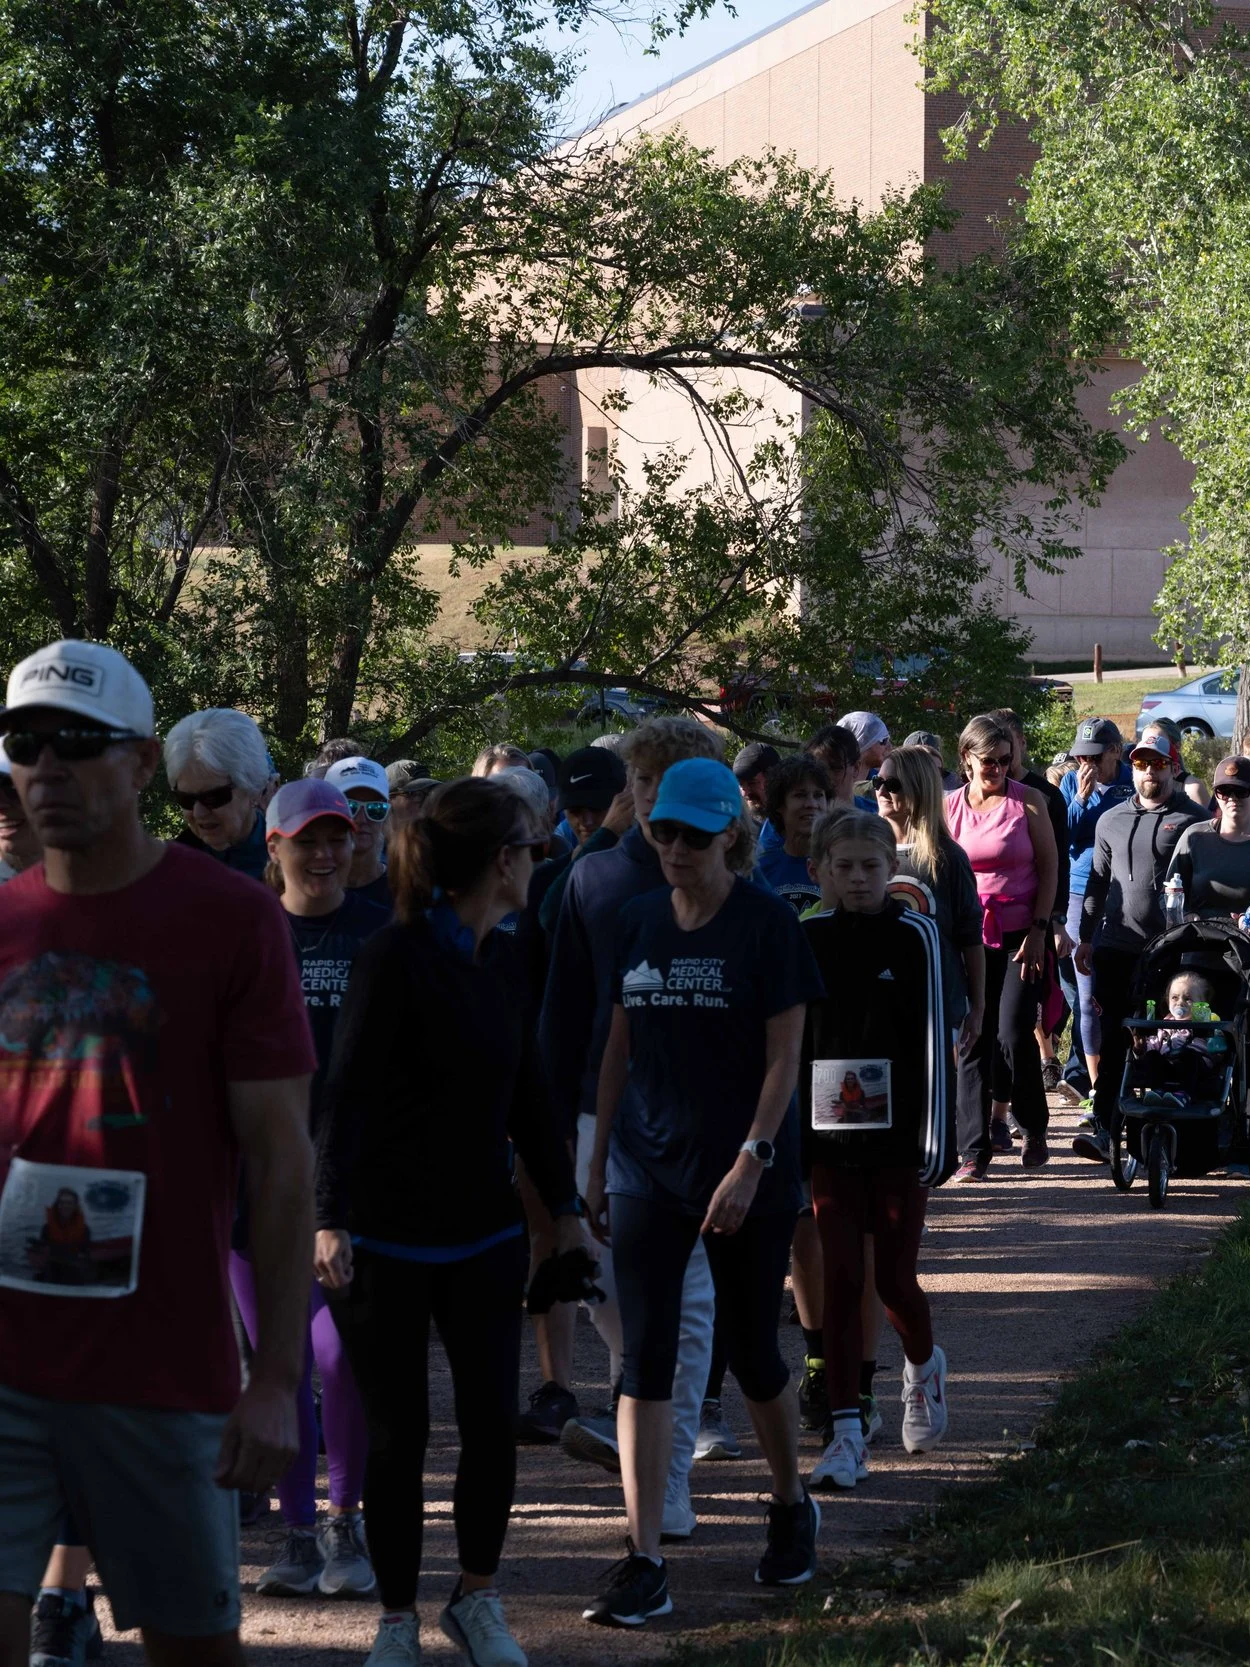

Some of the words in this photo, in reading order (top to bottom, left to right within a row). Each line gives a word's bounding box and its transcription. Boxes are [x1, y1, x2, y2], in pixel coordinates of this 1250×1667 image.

[21, 665, 93, 687] PING
[302, 959, 335, 968] RAPID
[336, 959, 352, 968] CIT
[671, 958, 700, 966] RAPID
[702, 958, 727, 967] CITY
[668, 966, 724, 978] MEDICAL
[301, 979, 349, 992] CENTE
[666, 978, 722, 991] CENTER
[303, 995, 325, 1007] re.
[622, 993, 647, 1009] Live.
[650, 992, 689, 1007] Care.
[693, 993, 730, 1009] Run.
